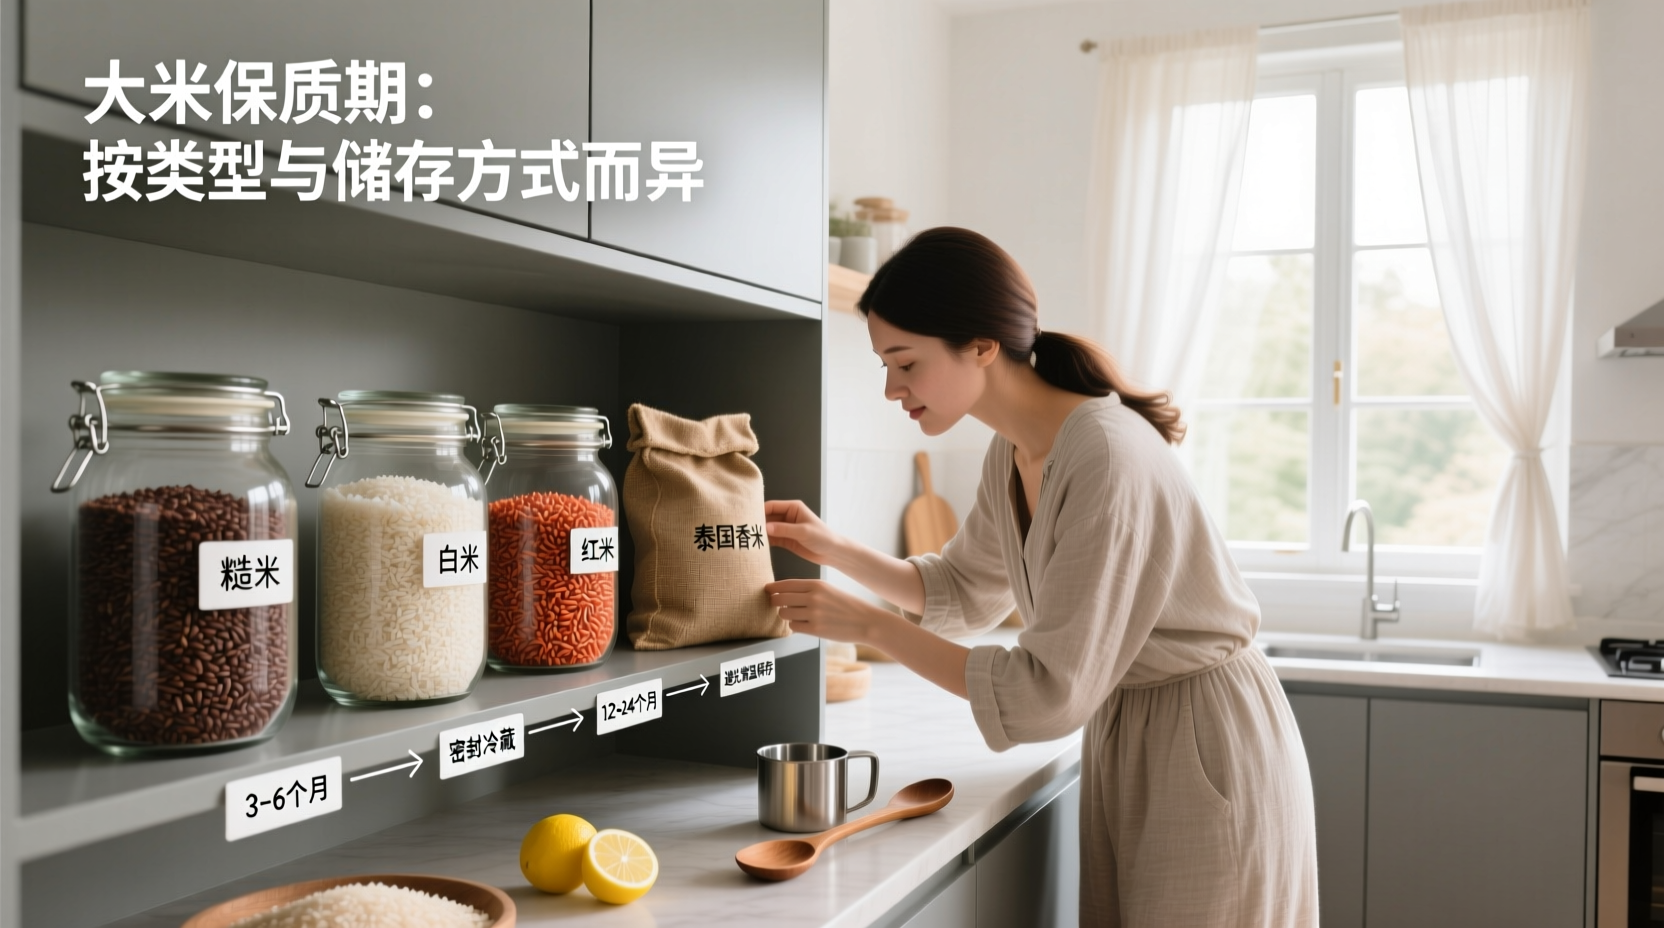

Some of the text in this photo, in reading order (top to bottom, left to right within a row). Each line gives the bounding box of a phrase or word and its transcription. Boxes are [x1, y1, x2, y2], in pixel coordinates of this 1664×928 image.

[581, 537, 614, 562] 红米
[694, 523, 764, 551] 泰国香米
[220, 554, 280, 591] 糙米
[439, 544, 479, 574] 白米
[601, 690, 657, 721] 12-24个月
[449, 726, 516, 764] 密封冷藏
[245, 774, 327, 818] 3-6个月
